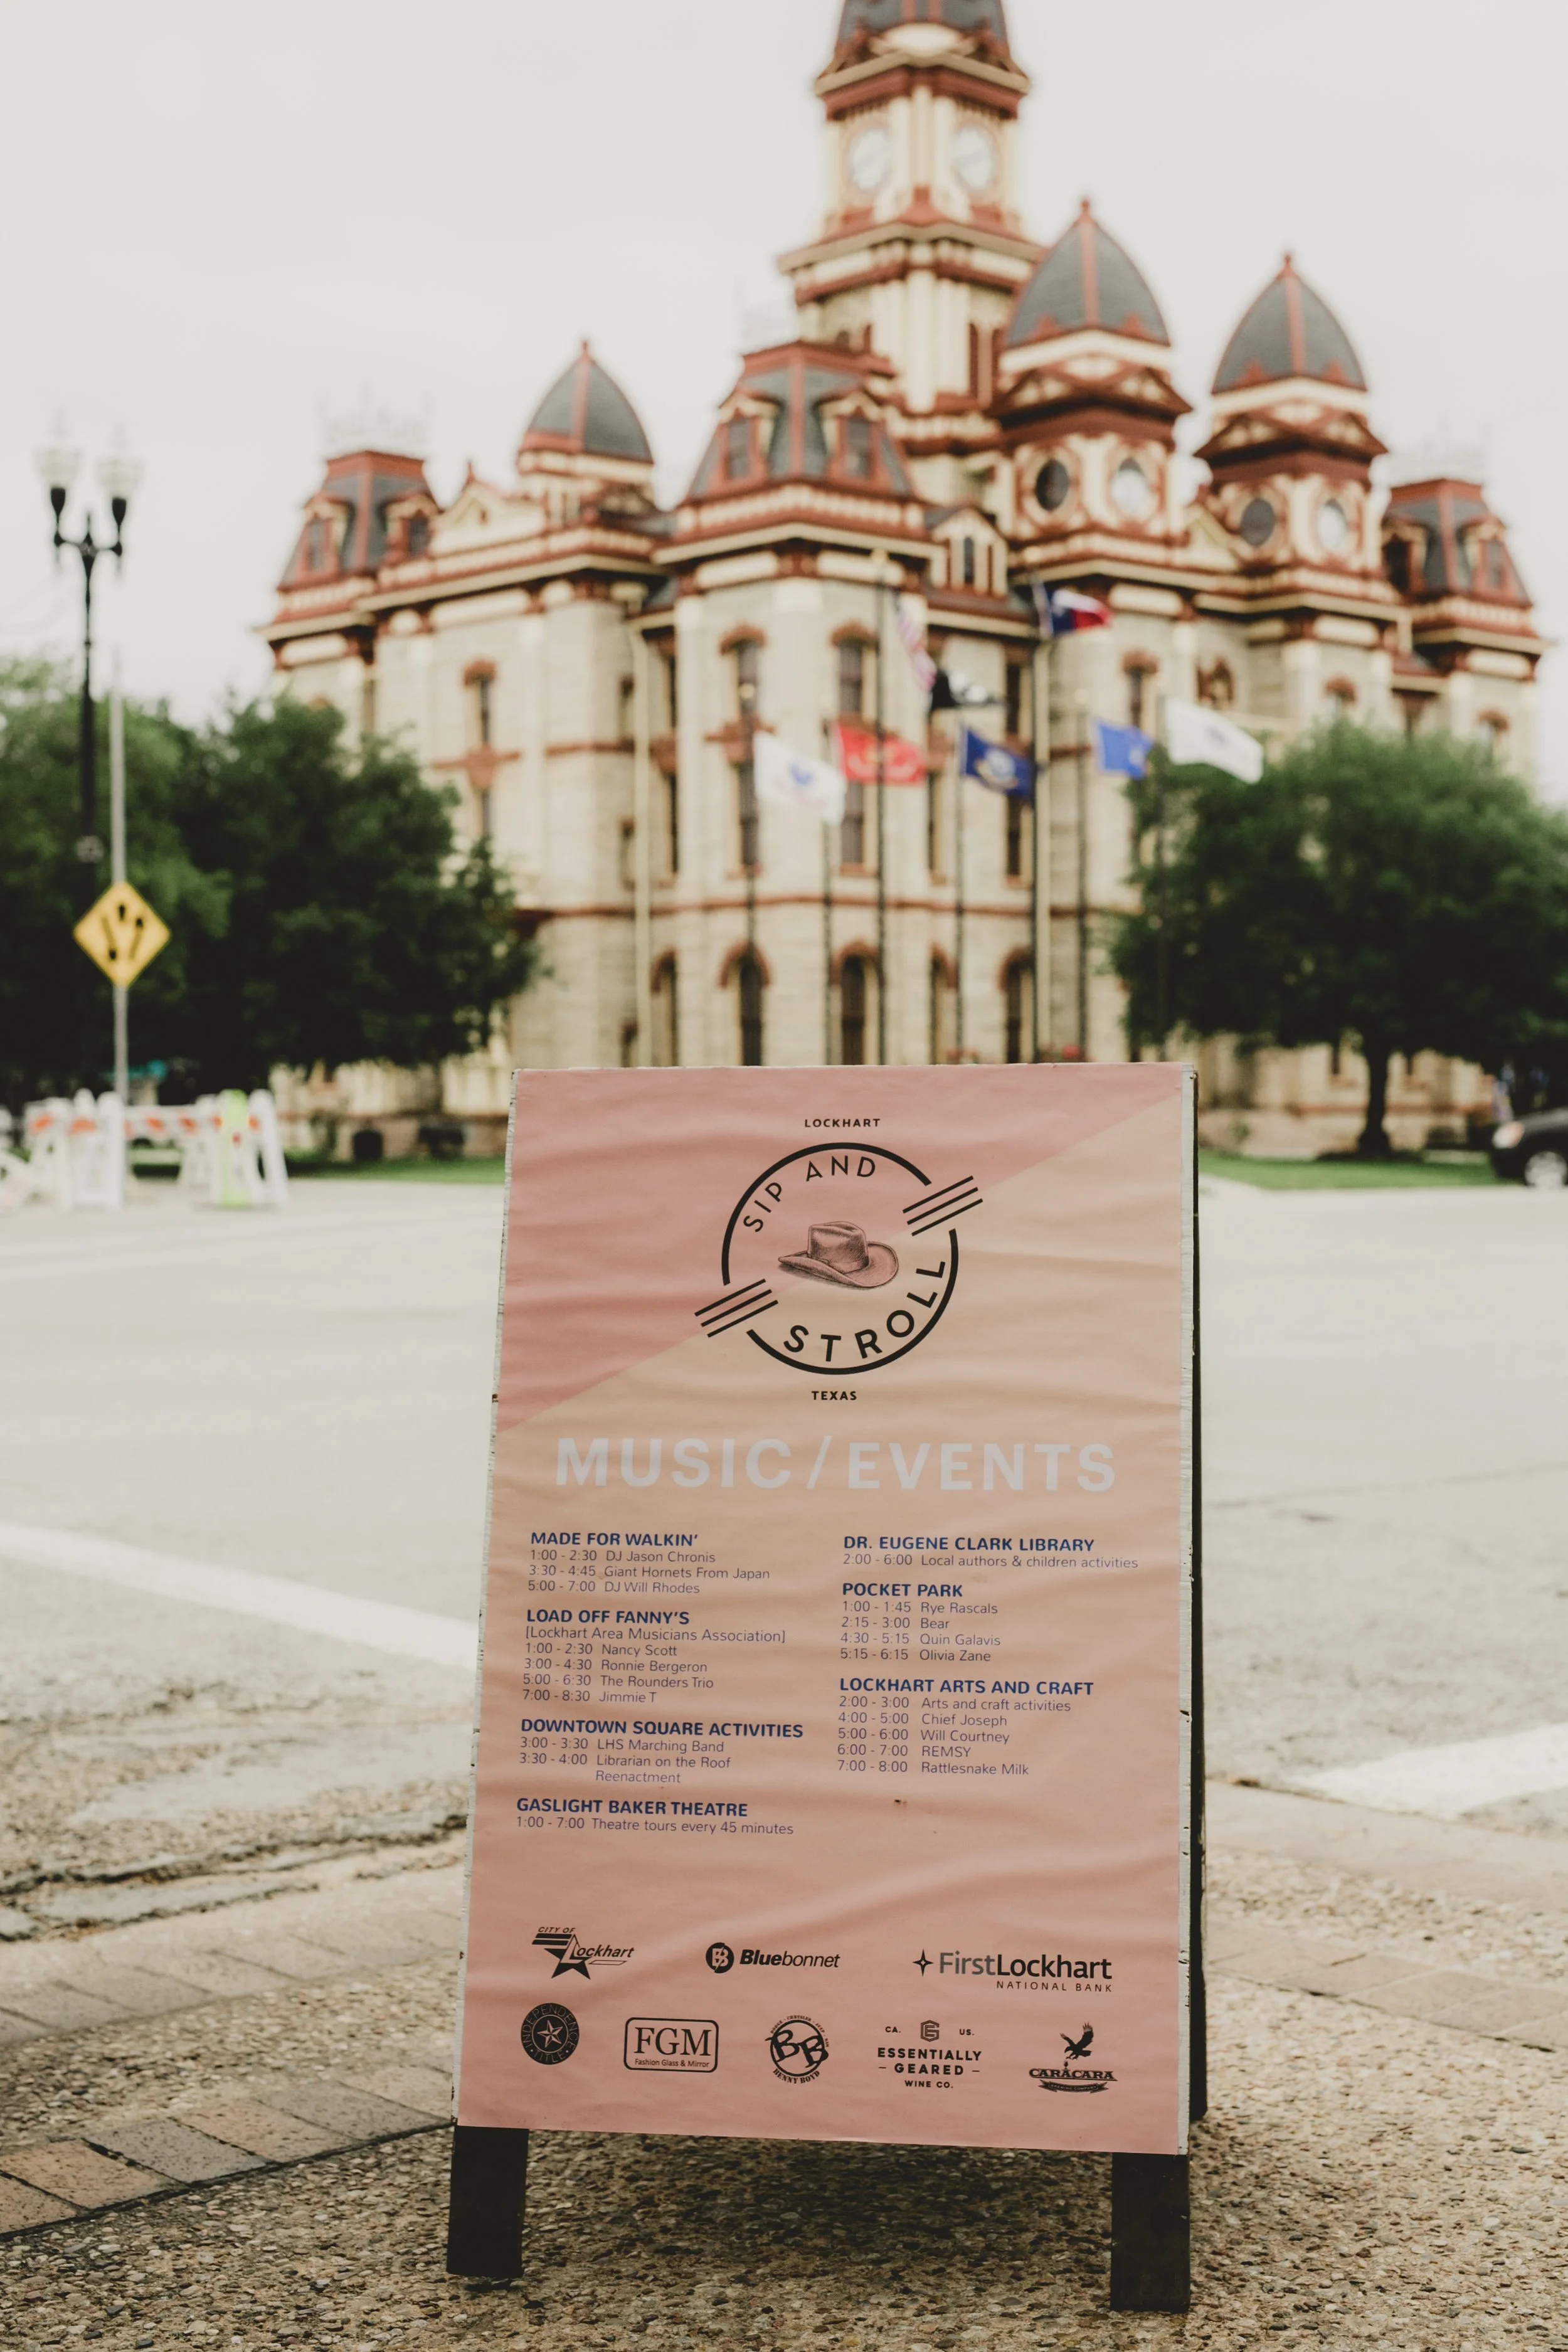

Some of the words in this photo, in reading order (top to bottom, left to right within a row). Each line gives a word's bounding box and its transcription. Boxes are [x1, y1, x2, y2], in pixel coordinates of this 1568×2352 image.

[805, 1119, 881, 1128] LOCKHART
[743, 1182, 783, 1232] SIP
[806, 1155, 876, 1182] AND
[783, 1261, 945, 1362] STROLL
[812, 1391, 857, 1401] TEXAS
[531, 1532, 581, 1545] MADE
[587, 1533, 620, 1545] FOR
[625, 1534, 697, 1546] WALKIN'
[844, 1536, 872, 1549] DR.
[879, 1536, 948, 1550] EUGENE
[955, 1537, 1012, 1550] CLARK
[1020, 1539, 1094, 1552] LIBRARY
[531, 1549, 557, 1560] 1:00
[569, 1550, 597, 1560] 2:30
[607, 1550, 622, 1561] DJ
[627, 1551, 662, 1562] Jason
[668, 1551, 716, 1562] Chronis
[844, 1554, 871, 1564] 2:00
[884, 1554, 912, 1565] 6:00
[921, 1555, 953, 1565] Local
[958, 1555, 1007, 1567] authors
[1012, 1555, 1022, 1567] &
[1027, 1556, 1076, 1567] children
[1081, 1557, 1138, 1568] activities
[529, 1565, 556, 1576] 3:30
[568, 1565, 596, 1576] 4:45
[605, 1565, 637, 1577] Giant
[642, 1567, 691, 1577] Hornets
[697, 1567, 728, 1578] From
[733, 1568, 770, 1581] Japan
[528, 1580, 555, 1591] 5:00
[568, 1581, 595, 1591] 7:00
[605, 1581, 620, 1592] DJ
[624, 1582, 647, 1592] Will
[653, 1582, 699, 1593] Rhodes
[843, 1582, 911, 1596] POCKET
[918, 1584, 963, 1597] PARK
[843, 1601, 870, 1612] 1:00
[884, 1601, 911, 1613] 1:45
[921, 1602, 945, 1615] Rye
[950, 1602, 998, 1614] Rascals
[527, 1609, 572, 1623] LOAD
[578, 1610, 610, 1623] OFF
[616, 1611, 689, 1624] FANNY'S
[842, 1616, 869, 1628] 2:15
[882, 1617, 910, 1628] 3:00
[921, 1618, 950, 1629] Bear
[591, 1627, 623, 1639] Area
[629, 1628, 697, 1640] Musicians
[840, 1632, 869, 1643] 4:30
[882, 1633, 909, 1644] 5:15
[920, 1633, 950, 1644] Quin
[955, 1634, 1000, 1645] Galavis
[526, 1643, 552, 1653] 1:00
[565, 1643, 593, 1655] 2:30
[602, 1644, 640, 1658] Nancy
[645, 1645, 677, 1656] Scott
[840, 1648, 868, 1660] 5:15
[881, 1648, 908, 1660] 6:15
[919, 1649, 955, 1661] Olivia
[960, 1650, 991, 1661] Zane
[525, 1658, 552, 1669] 3:00
[564, 1659, 591, 1670] 4:30
[601, 1660, 645, 1671] Ronnie
[650, 1660, 707, 1675] Bergeron
[523, 1673, 550, 1685] 5:00
[563, 1675, 591, 1685] 6:30
[600, 1675, 623, 1686] The
[628, 1676, 688, 1688] Rounders
[691, 1677, 714, 1688] Trio
[840, 1678, 935, 1692] LOCKHART
[940, 1680, 985, 1693] ARTS
[991, 1681, 1030, 1694] AND
[1036, 1682, 1094, 1695] CRAFT
[522, 1689, 550, 1701] 7:00
[562, 1690, 590, 1701] 8:30
[599, 1692, 646, 1702] Jimmie
[649, 1692, 657, 1702] T
[839, 1696, 867, 1707] 2:00
[881, 1697, 909, 1708] 3:00
[921, 1697, 948, 1708] Arts
[953, 1698, 976, 1709] and
[981, 1698, 1009, 1710] craft
[1014, 1700, 1071, 1711] activities
[839, 1712, 867, 1723] 4:00
[881, 1713, 908, 1724] 5:00
[922, 1714, 956, 1725] Chief
[960, 1715, 1007, 1728] Joseph
[521, 1719, 627, 1734] DOWNTOWN
[633, 1721, 704, 1735] SQUARE
[709, 1722, 803, 1738] ACTIVITIES
[839, 1727, 867, 1739] 5:00
[879, 1729, 908, 1740] 6:00
[921, 1729, 945, 1740] Will
[950, 1730, 1010, 1745] Courtney
[521, 1737, 548, 1748] 3:00
[561, 1737, 588, 1749] 3:30
[598, 1739, 623, 1750] LHS
[629, 1739, 687, 1754] Marching
[692, 1740, 724, 1752] Band
[838, 1744, 866, 1755] 6:00
[880, 1745, 908, 1756] 7:00
[922, 1745, 971, 1757] REMSY
[520, 1752, 546, 1764] 3:30
[559, 1754, 587, 1765] 4:00
[597, 1754, 650, 1766] Librarian
[655, 1759, 670, 1767] on
[675, 1756, 696, 1767] the
[701, 1757, 731, 1768] Roof
[838, 1760, 866, 1771] 7:00
[879, 1761, 908, 1772] 8:00
[922, 1762, 997, 1774] Rattlesnake
[1002, 1764, 1029, 1775] Milk
[596, 1771, 681, 1783] Reenactment
[517, 1798, 603, 1813] GASLIGHT
[609, 1800, 666, 1814] BAKER
[670, 1802, 748, 1816] THEATRE
[517, 1816, 544, 1828] 1:00
[557, 1817, 585, 1828] 7:00
[591, 1818, 639, 1830] Theatre
[644, 1820, 677, 1831] tours
[681, 1823, 716, 1835] every
[721, 1821, 736, 1833] 45
[741, 1822, 793, 1834] minutes
[560, 1934, 635, 1964] Lockhart
[739, 1949, 840, 1968] Bluebonnet
[940, 1951, 1112, 1979] FirstLockhart
[997, 1981, 1067, 1991] NATIONAL
[1076, 1983, 1112, 1992] BANK
[522, 2005, 578, 2051] INDEPENDENCE
[633, 2027, 712, 2056] FGM
[533, 2048, 566, 2063] TITLE
[878, 2047, 982, 2061] ESSENTIALLY
[773, 2068, 799, 2084] BENNY
[894, 2063, 963, 2075] GEARED
[1029, 2069, 1114, 2080] CARACARA
